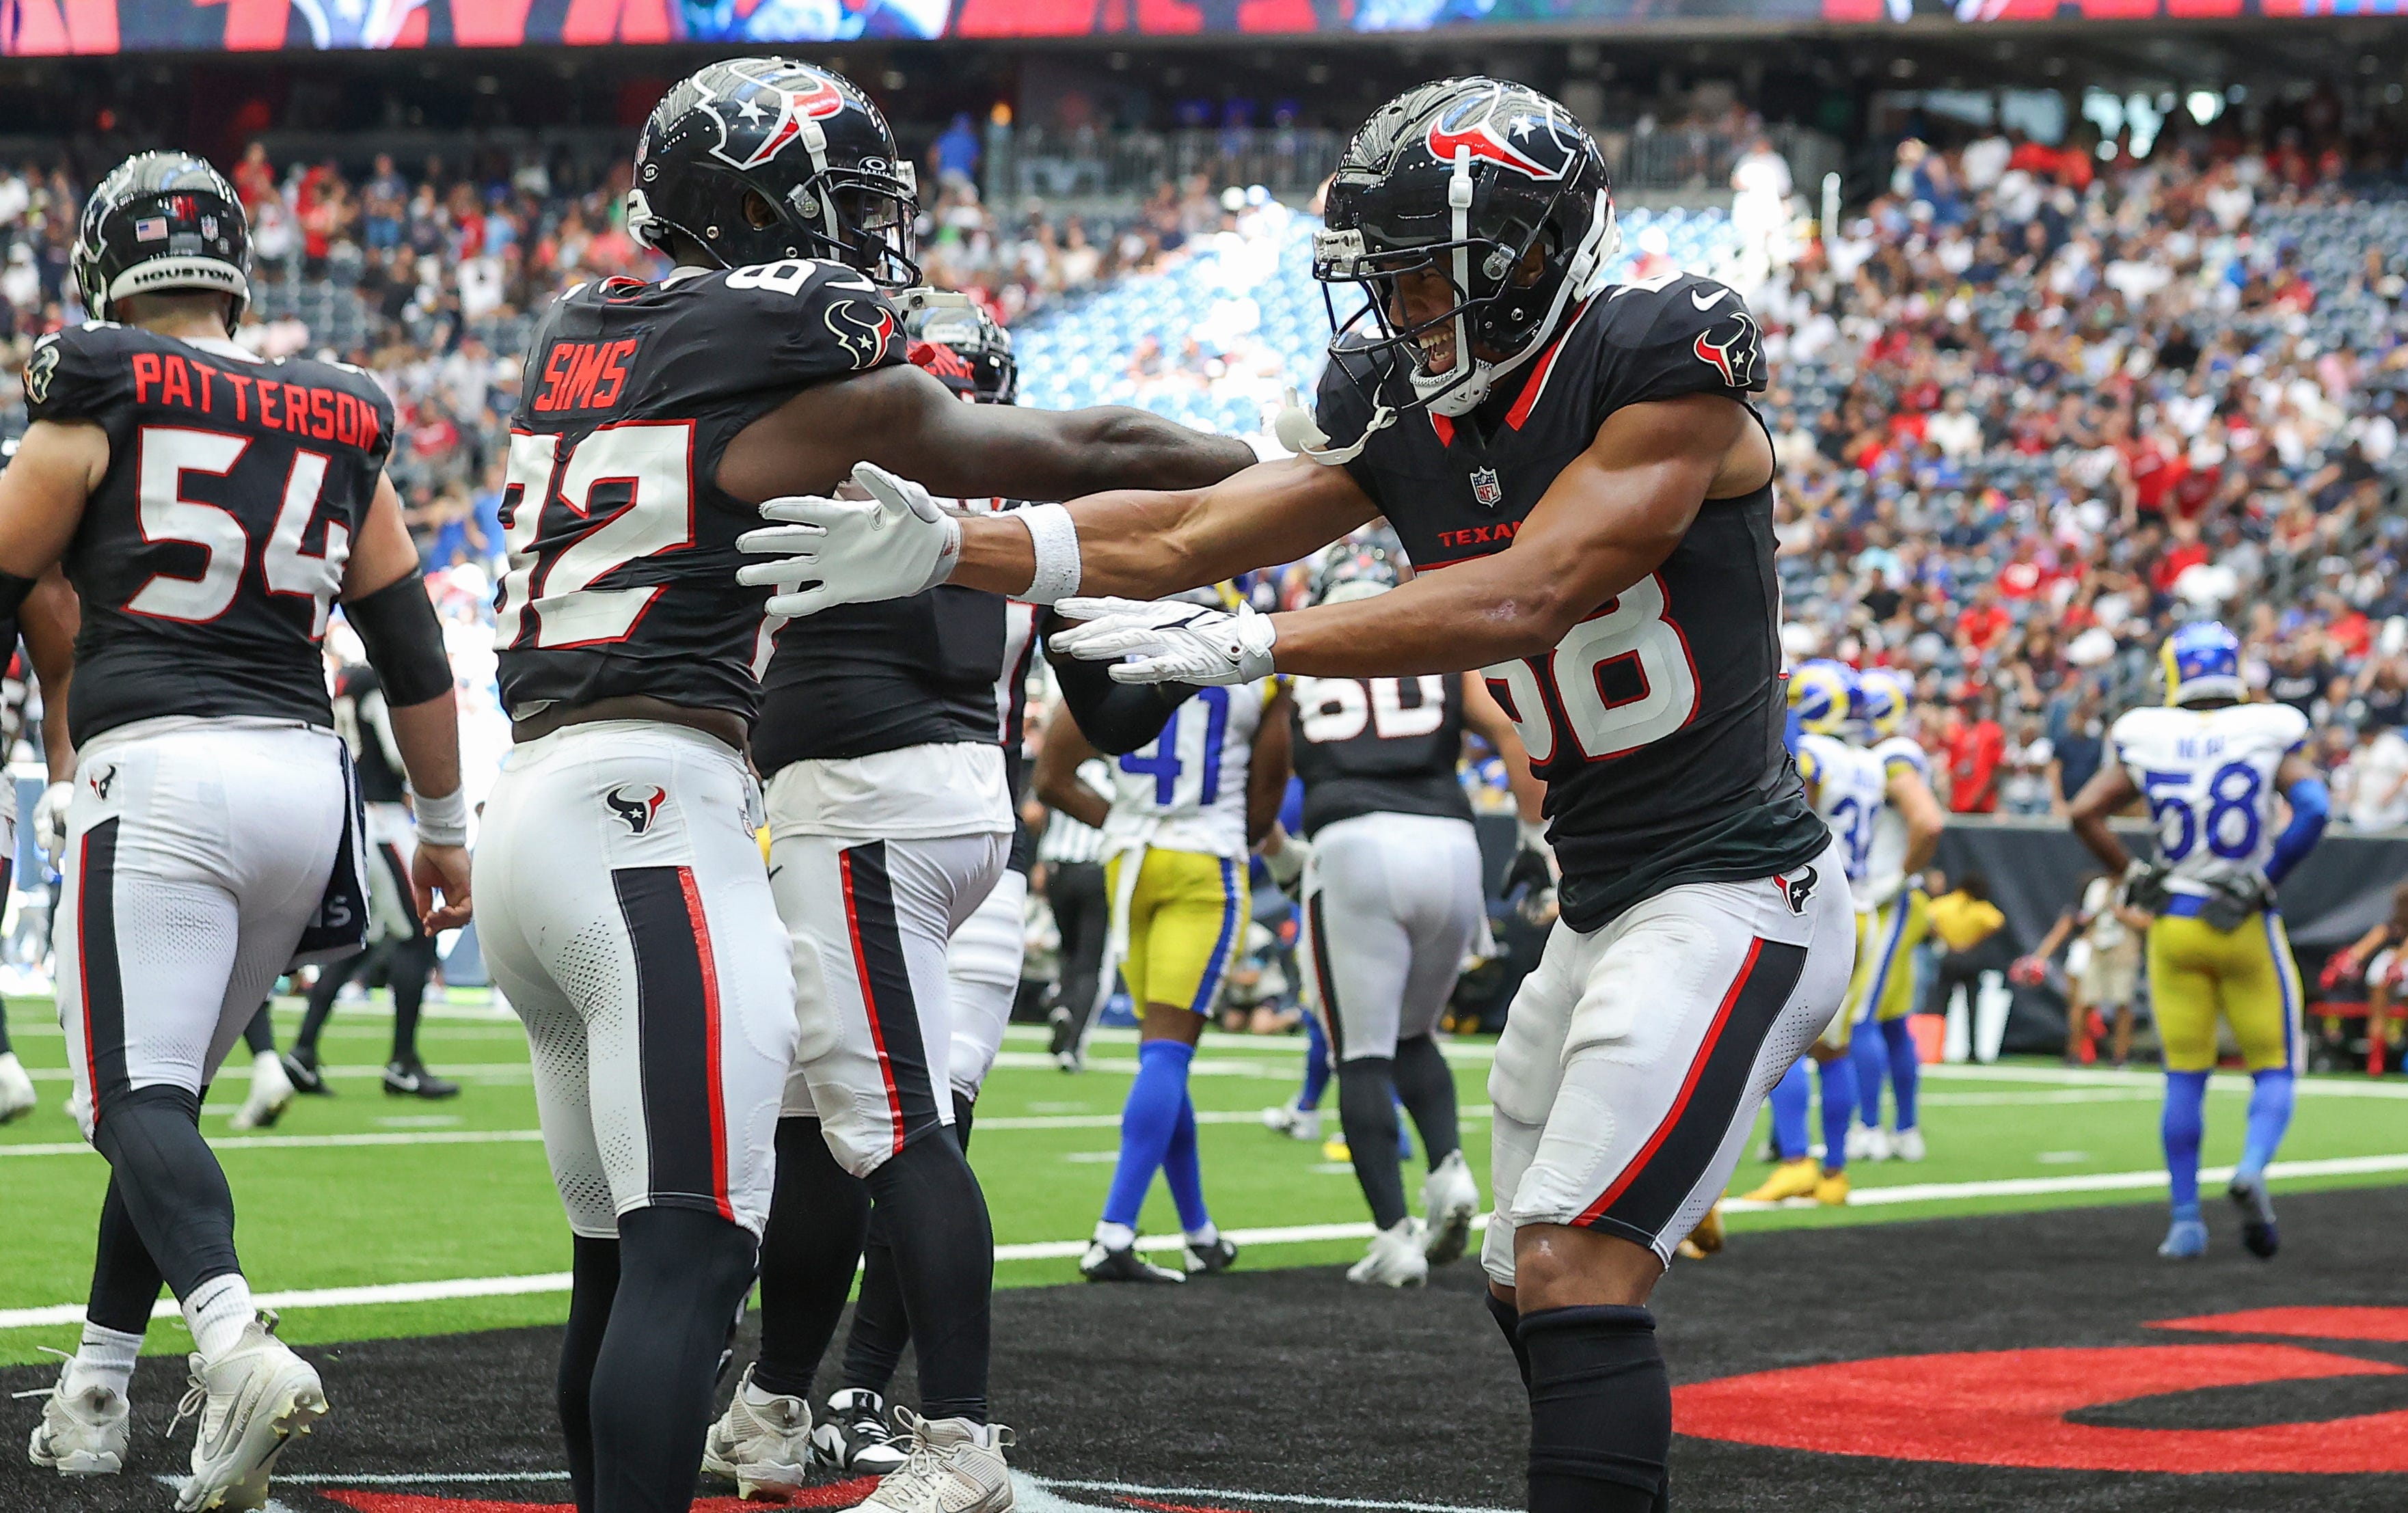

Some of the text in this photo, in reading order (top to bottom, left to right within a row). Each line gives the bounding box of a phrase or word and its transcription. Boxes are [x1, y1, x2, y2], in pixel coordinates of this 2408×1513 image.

[134, 268, 234, 285] HOUSTON
[132, 353, 381, 453] PATTERSON
[535, 338, 636, 412] SIMS
[120, 426, 351, 641] 54
[1478, 485, 1497, 500] NFL
[1119, 685, 1229, 806] 41
[2145, 762, 2261, 861] 58
